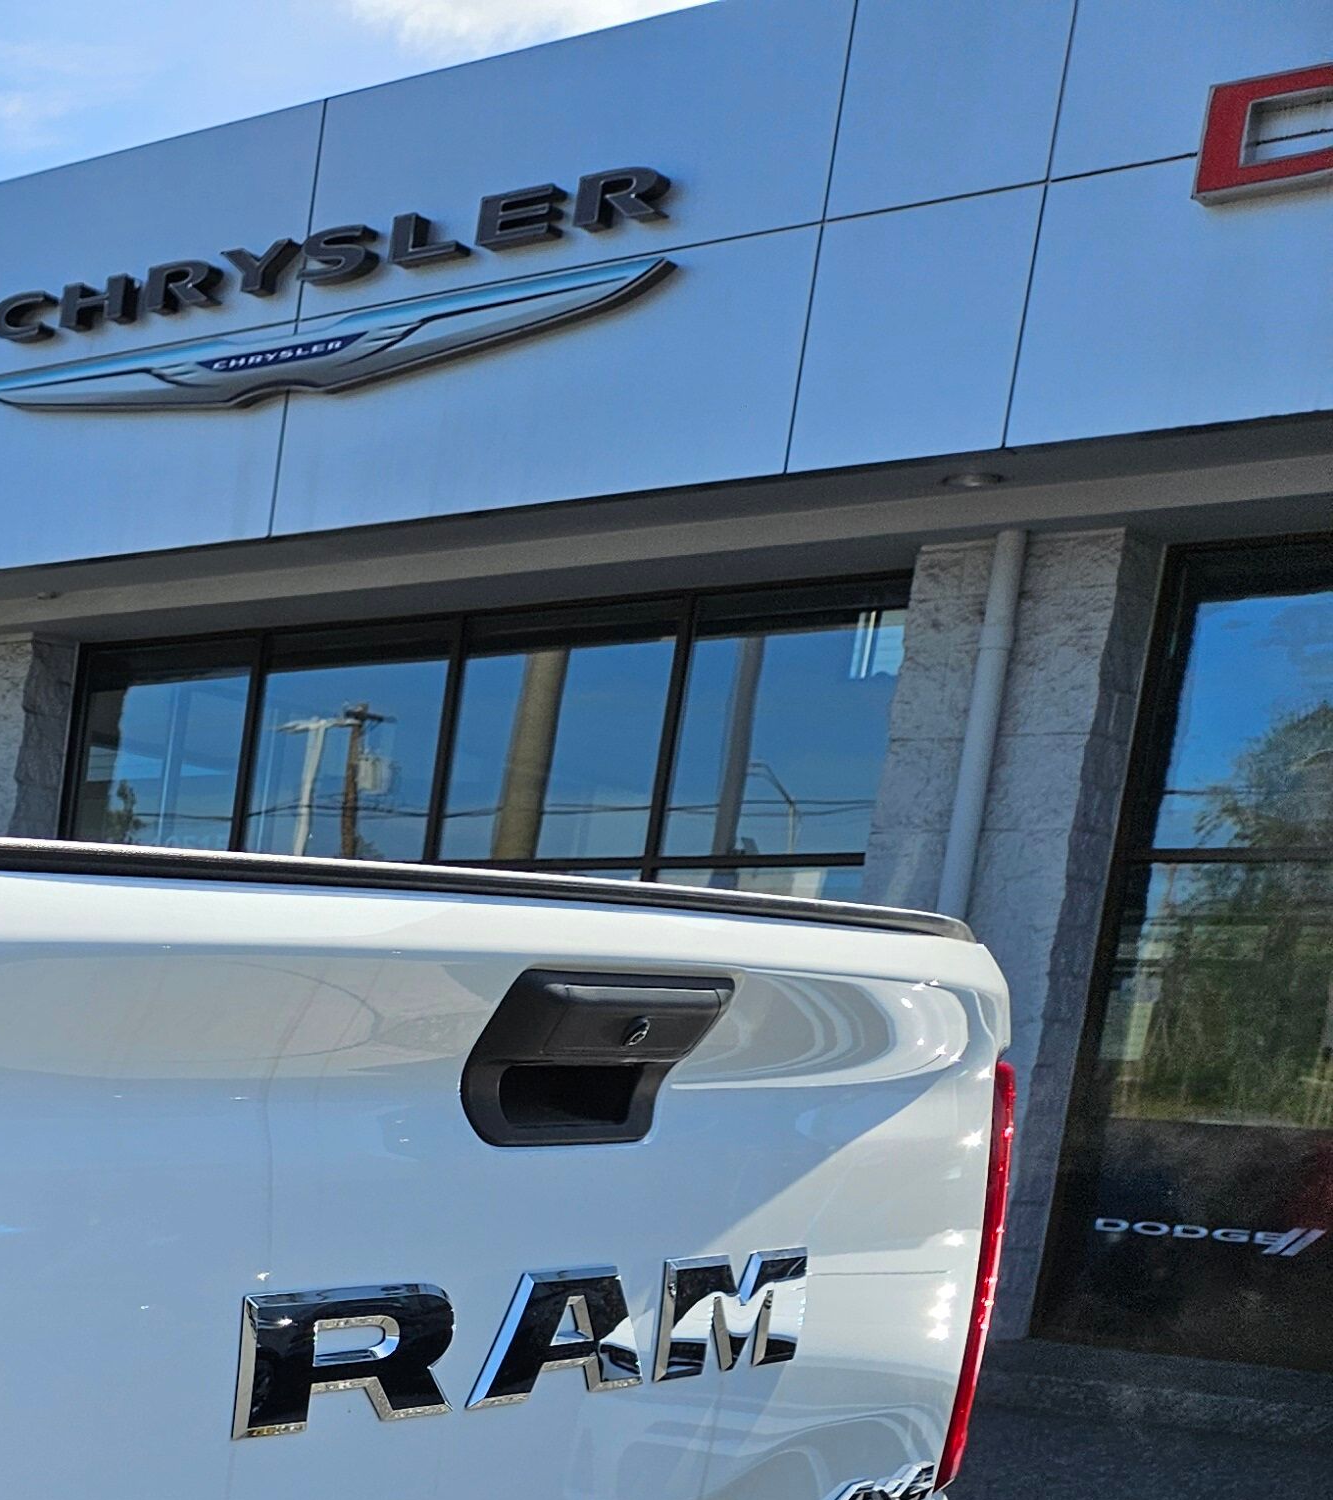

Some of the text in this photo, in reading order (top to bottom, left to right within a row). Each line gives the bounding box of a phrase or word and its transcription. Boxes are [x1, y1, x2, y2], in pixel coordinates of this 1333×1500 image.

[213, 340, 342, 370] CHRYSLER
[1095, 1218, 1288, 1246] DODGE
[231, 1246, 808, 1440] RAM
